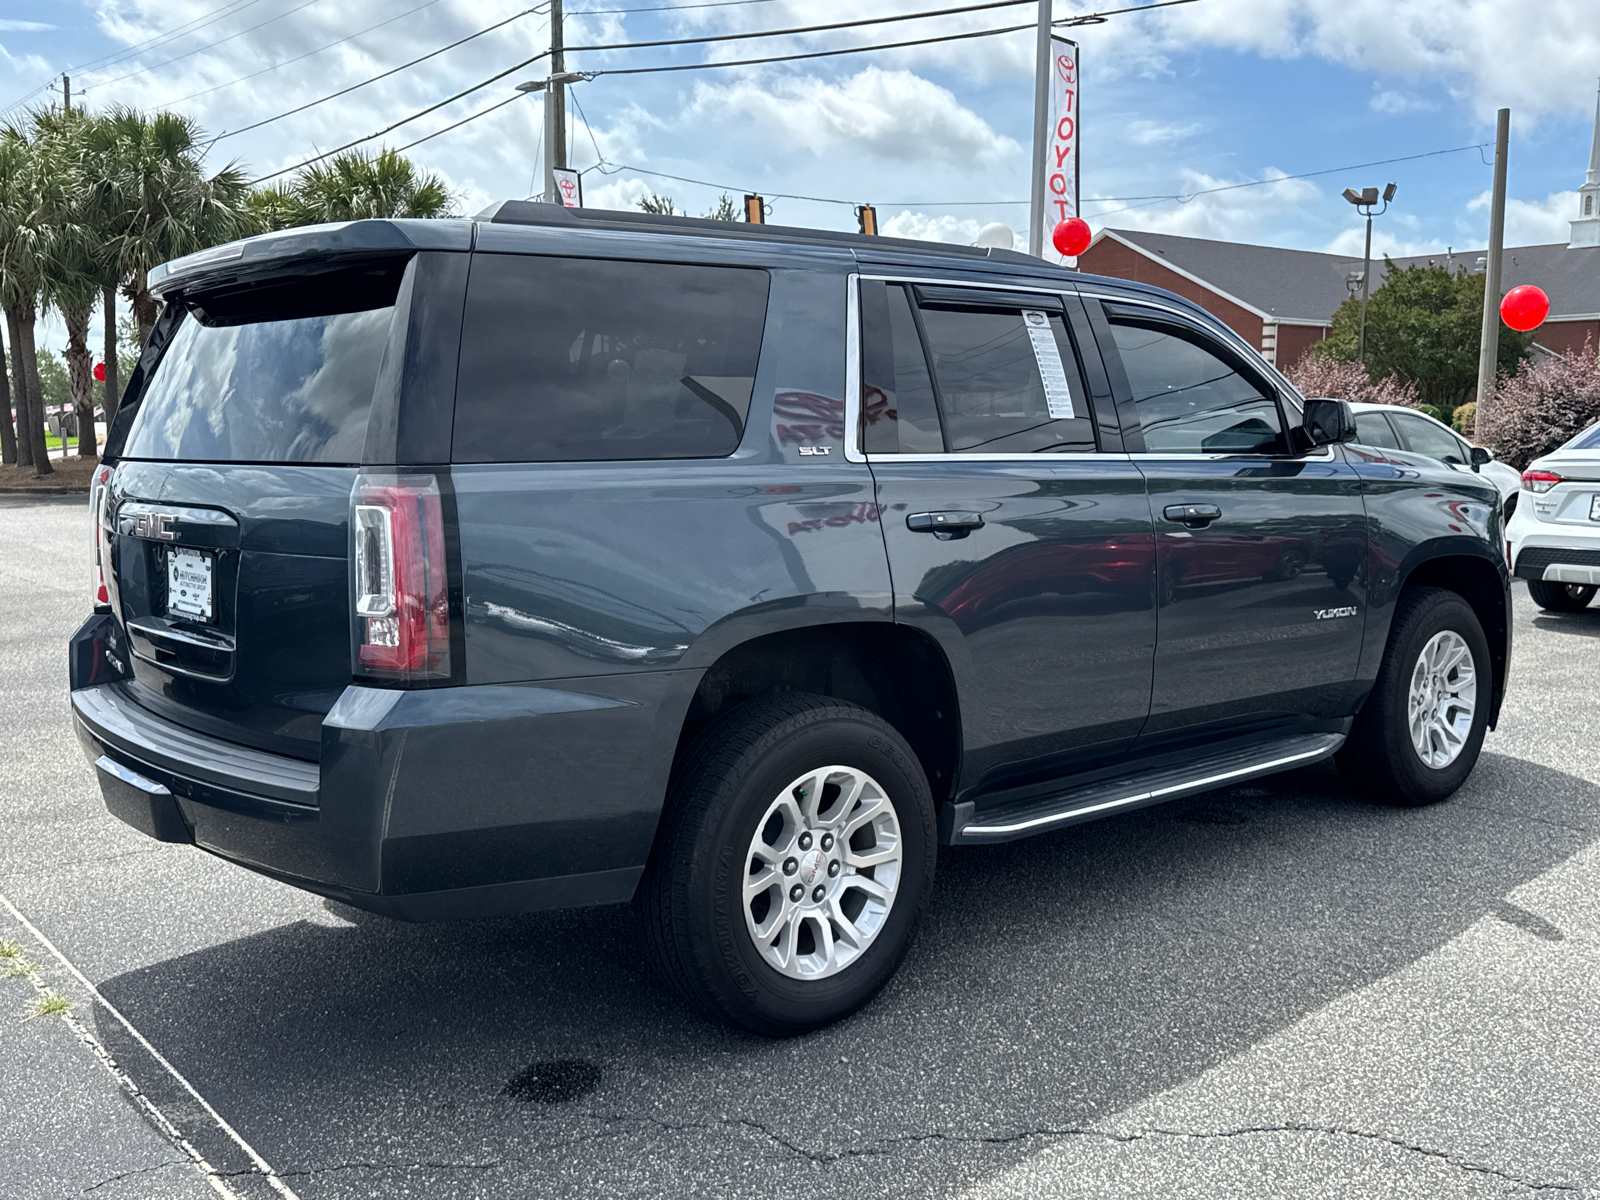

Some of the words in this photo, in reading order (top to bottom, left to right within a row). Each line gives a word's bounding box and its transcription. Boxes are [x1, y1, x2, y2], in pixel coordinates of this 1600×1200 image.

[1049, 89, 1074, 220] TOYOT
[798, 446, 832, 456] SLT
[136, 512, 179, 540] GMC
[1313, 606, 1357, 620] YUKON
[808, 853, 821, 883] GMC
[715, 845, 760, 1001] YOKOHAMA
